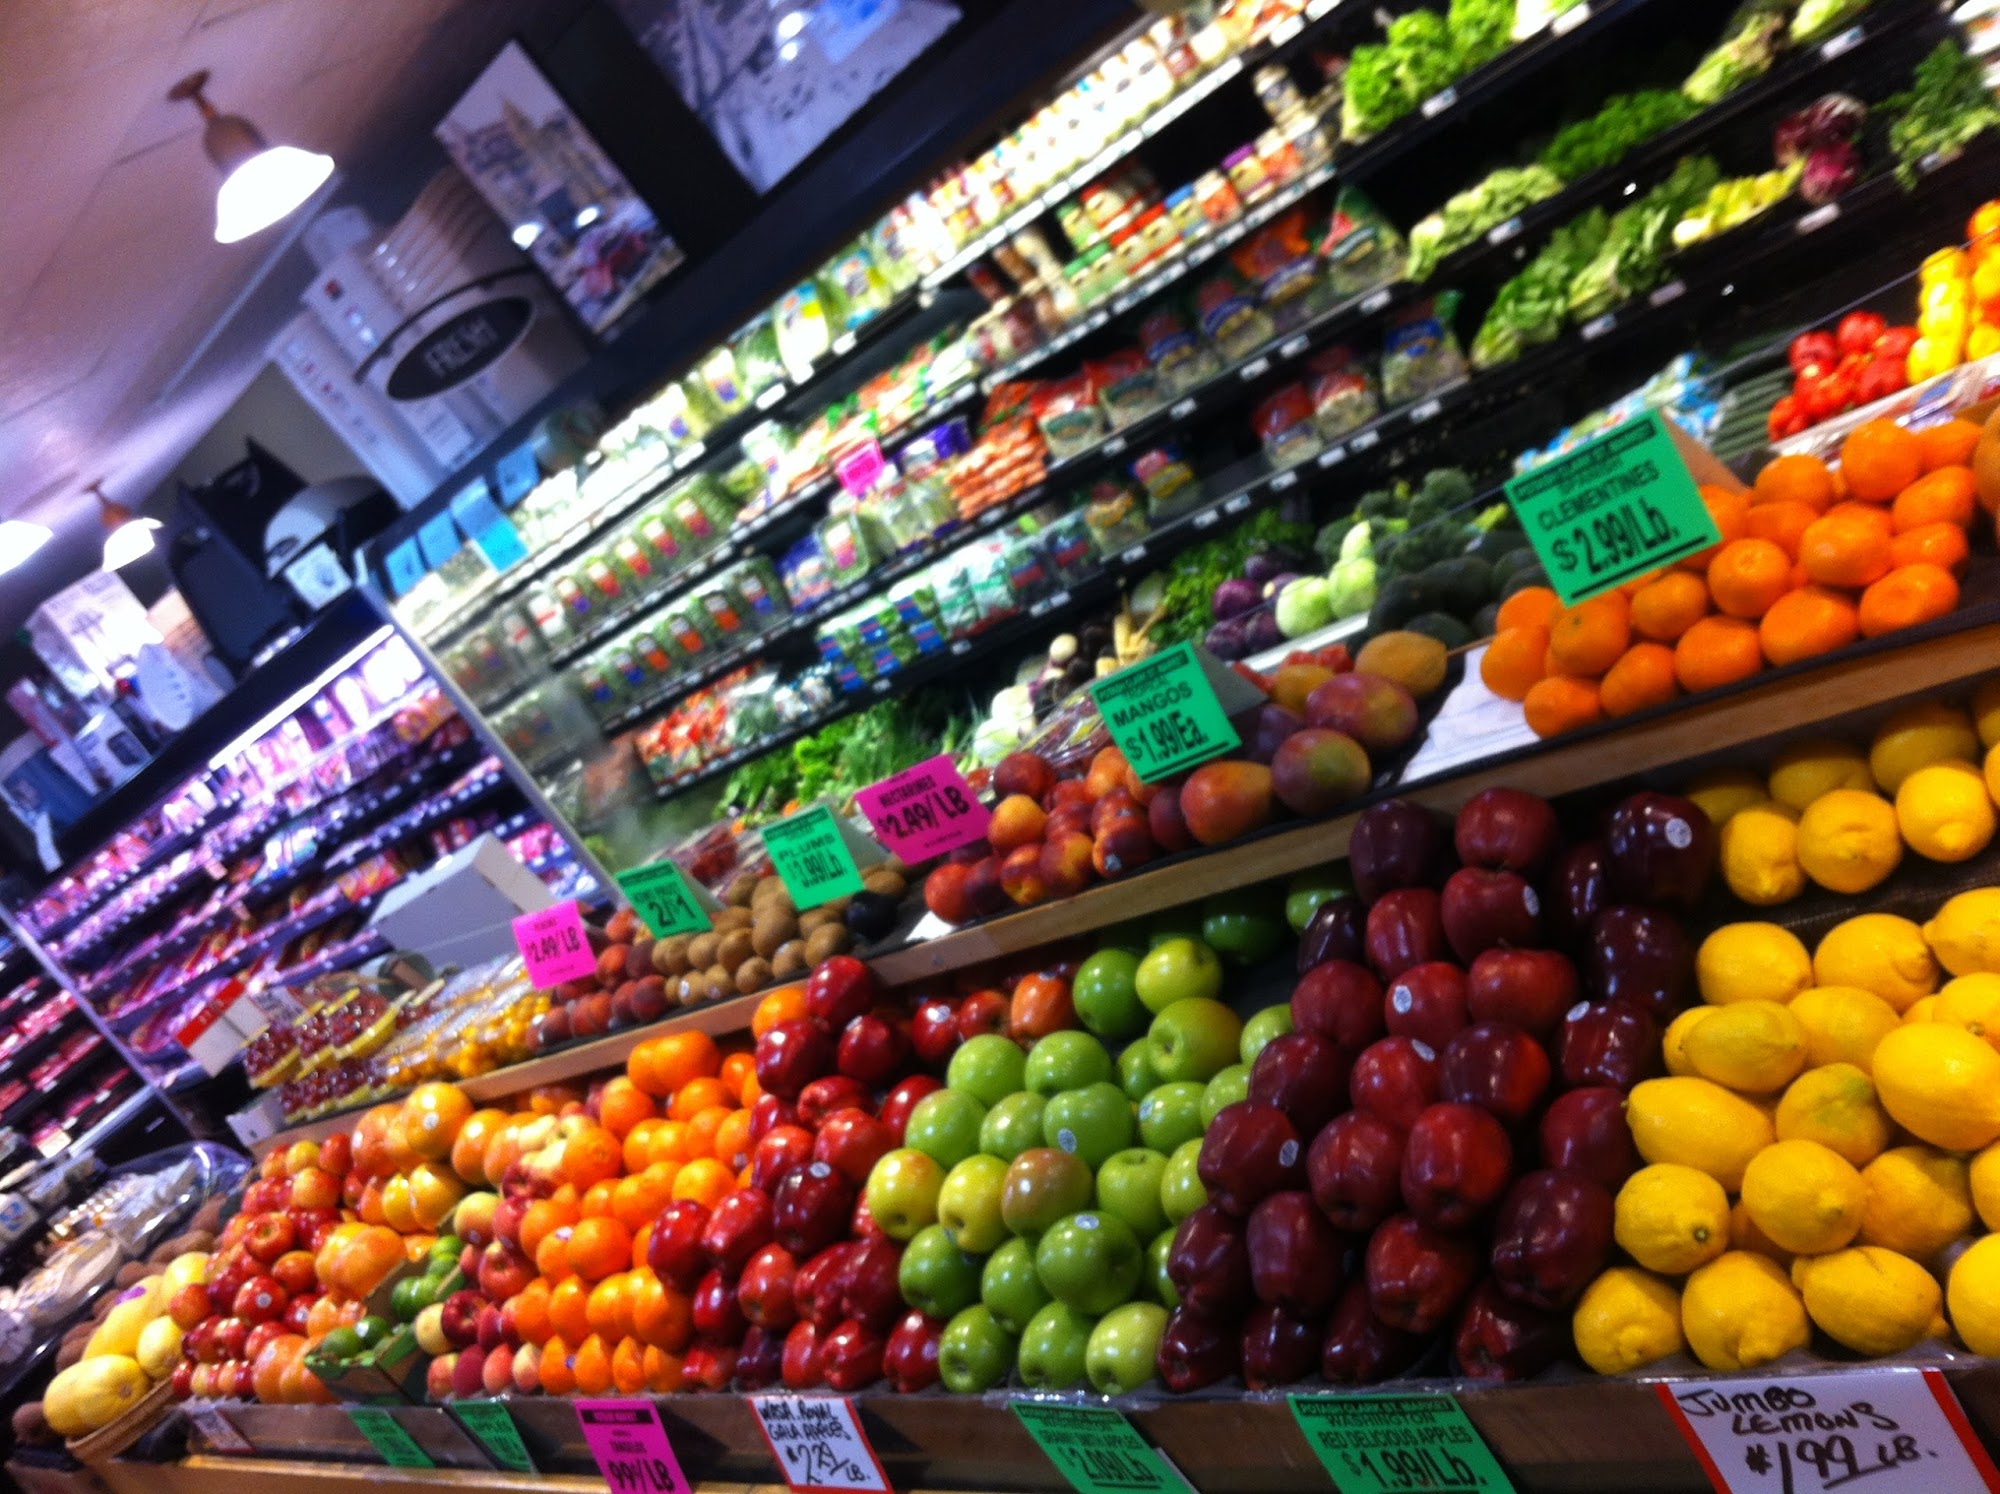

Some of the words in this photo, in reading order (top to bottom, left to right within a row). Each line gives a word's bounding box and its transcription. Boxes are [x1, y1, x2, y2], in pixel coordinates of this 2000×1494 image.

[424, 318, 499, 377] FRESH
[1538, 459, 1661, 532] CLEMENTINES
[1111, 680, 1194, 728] MANGOS
[778, 832, 836, 862] PLUMS
[1676, 1386, 1817, 1417] JUMBO
[768, 1423, 803, 1442] GALA
[1327, 1411, 1435, 1428] WASHINGTON
[1731, 1402, 1900, 1435] LEMONS
[1317, 1431, 1348, 1449] RED
[1348, 1427, 1418, 1449] DELICIOUS
[1417, 1425, 1473, 1445] APPLES
